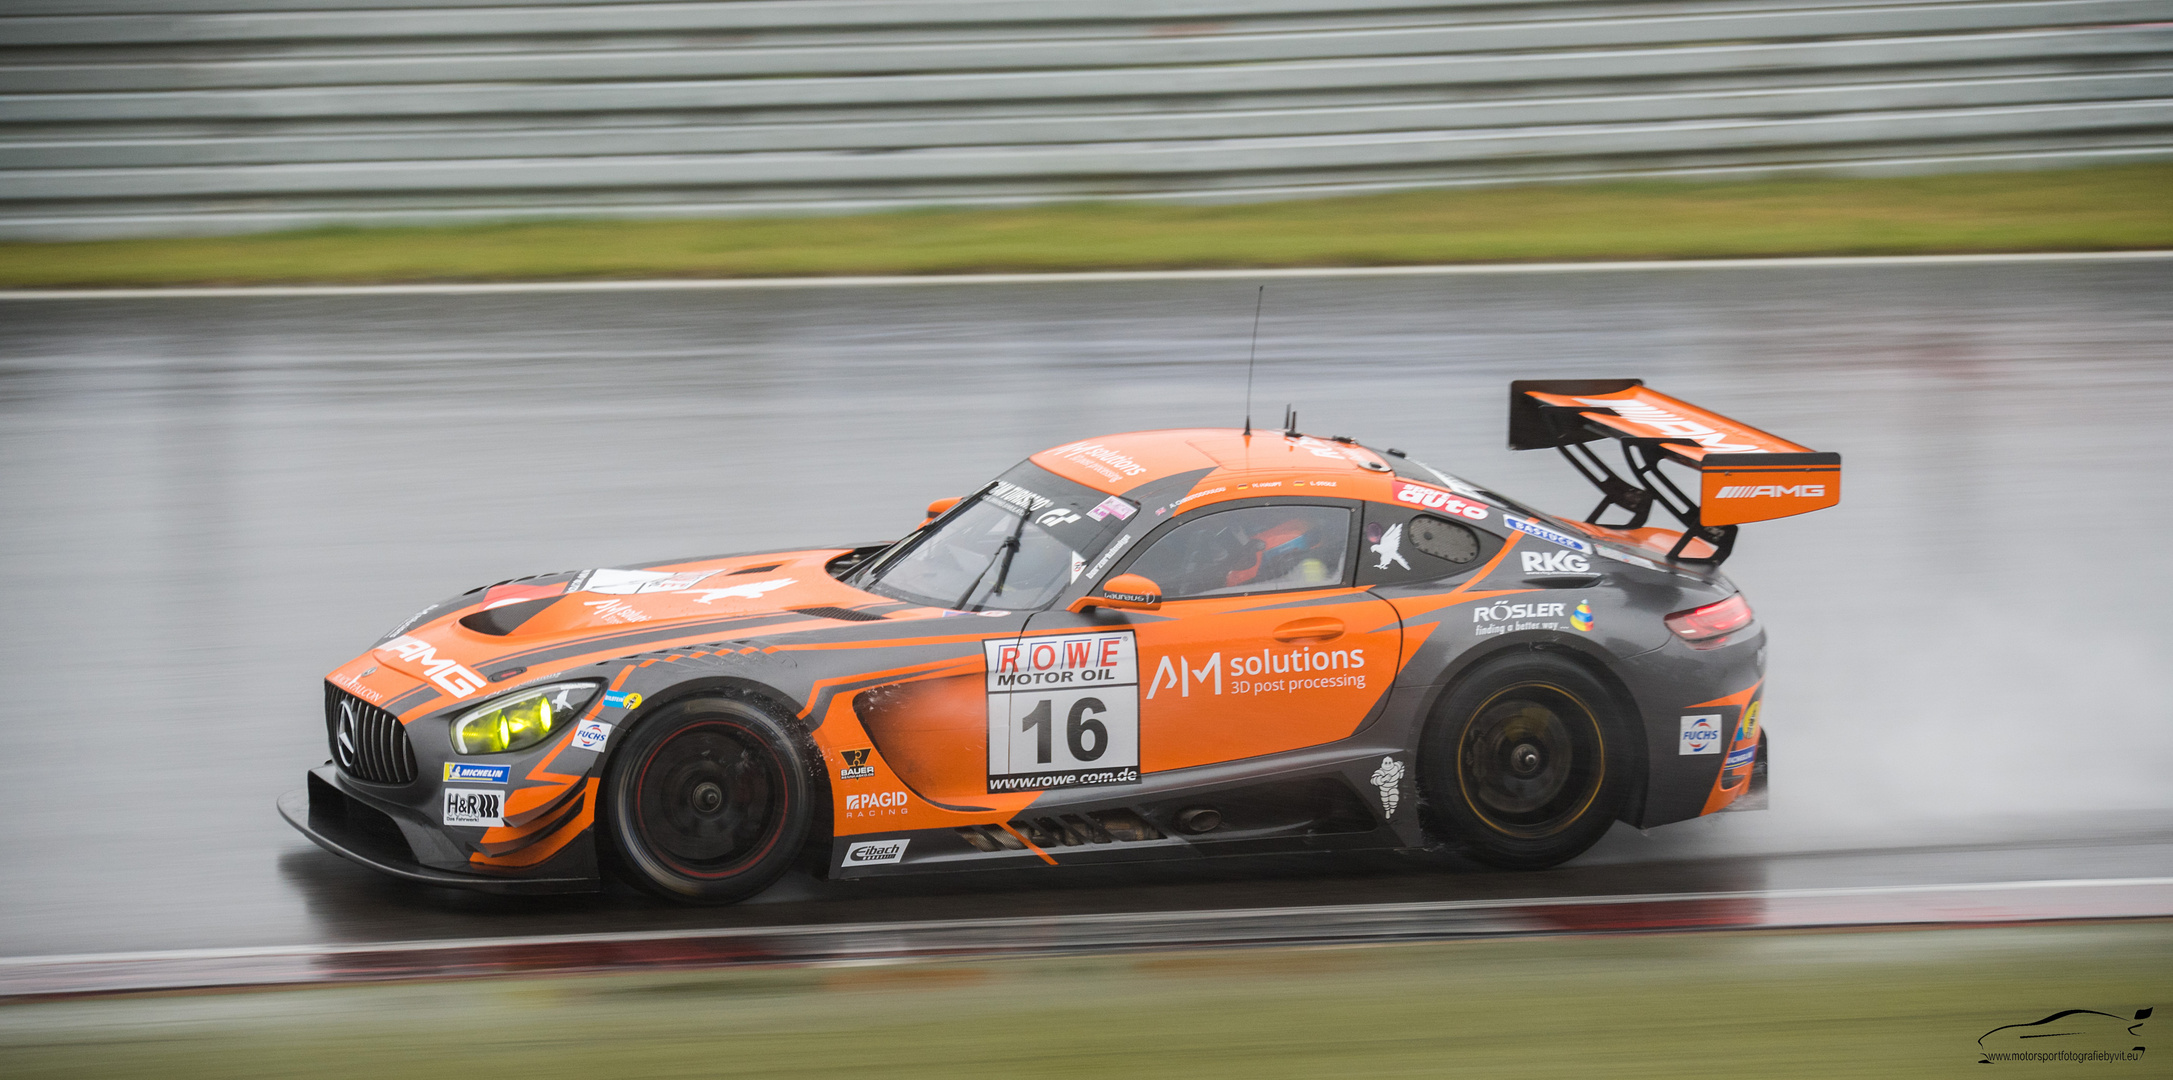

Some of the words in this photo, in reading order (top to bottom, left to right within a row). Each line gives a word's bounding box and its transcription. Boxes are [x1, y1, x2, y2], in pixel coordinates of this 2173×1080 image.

[1084, 447, 1147, 476] solutions
[1750, 485, 1825, 498] AMG
[1397, 491, 1489, 520] auto
[1515, 521, 1577, 548] BASTUCK
[1520, 550, 1591, 572] RKG
[1473, 600, 1564, 622] RÖSLER
[1475, 624, 1506, 635] finding
[1515, 621, 1540, 631] better
[1542, 622, 1559, 631] way
[998, 638, 1121, 673] ROWE
[386, 636, 487, 699] AMG
[997, 671, 1073, 686] MOTOR
[1081, 668, 1115, 681] OIL
[1146, 652, 1222, 699] AM
[1230, 647, 1365, 677] solutions
[350, 681, 383, 702] FALCON
[1231, 681, 1250, 694] 3D
[1254, 679, 1285, 695] post
[1289, 674, 1366, 693] processing
[577, 729, 606, 742] FUCHS
[1022, 697, 1108, 764] 16
[1682, 730, 1718, 740] FUCHS
[461, 768, 503, 778] MICHELIN
[841, 766, 874, 776] BAUER
[989, 768, 1137, 790] www.rowe.com.de
[448, 793, 477, 815] H&R
[861, 792, 908, 809] PAGID
[846, 808, 908, 818] RACING
[850, 844, 900, 861] Eibach
